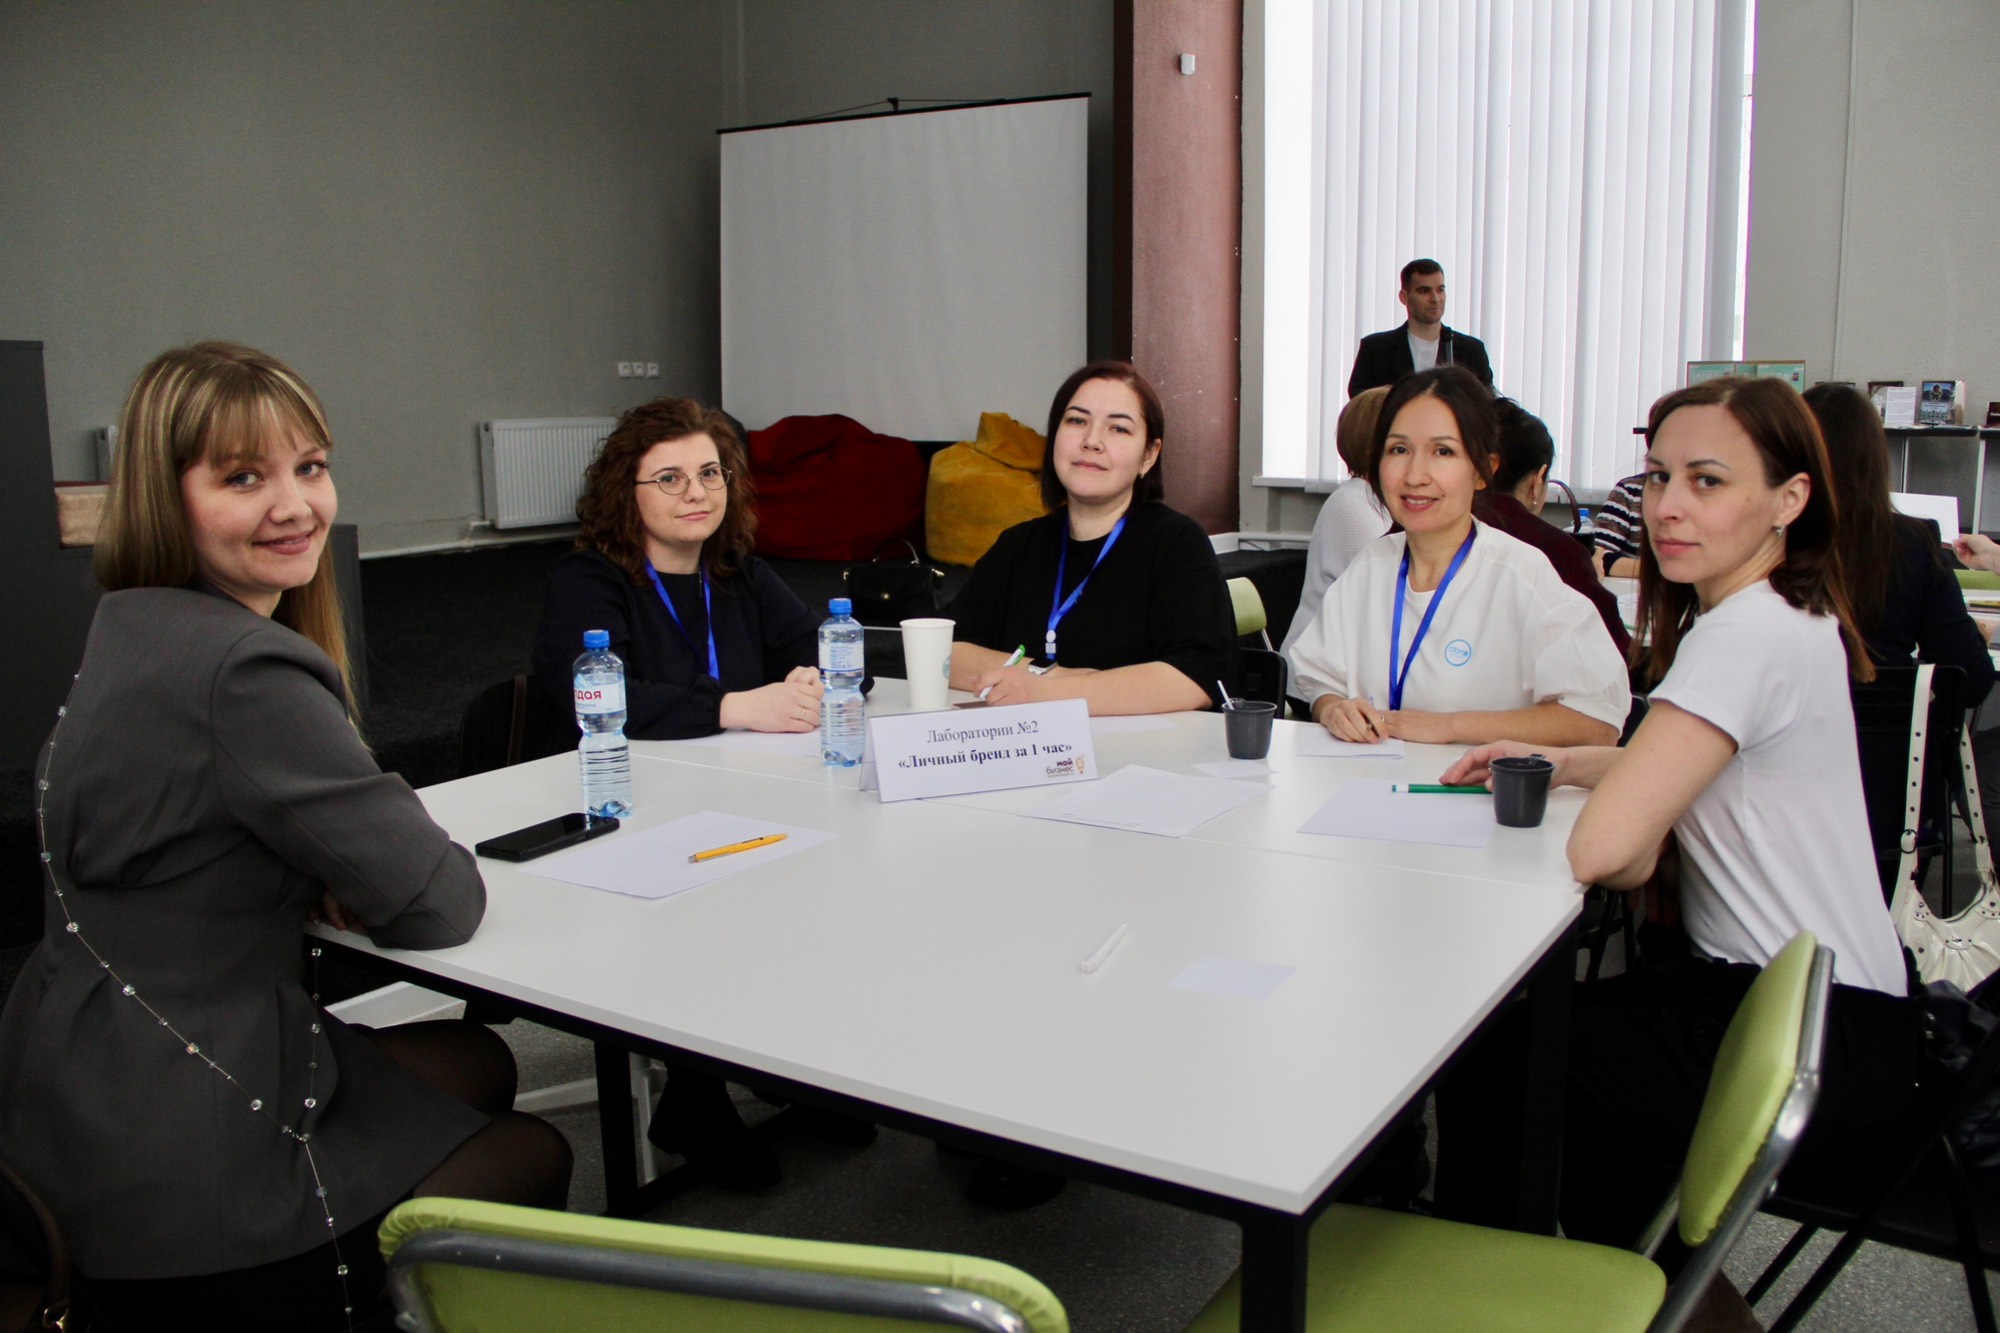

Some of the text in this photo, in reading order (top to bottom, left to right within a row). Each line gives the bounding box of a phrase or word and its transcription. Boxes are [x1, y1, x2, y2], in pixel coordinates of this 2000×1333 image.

[926, 720, 1038, 743] Лаборатории №2
[898, 743, 1072, 768] «Личный бренд за 1 час»
[1056, 757, 1073, 766] мой
[1046, 766, 1074, 774] бизнес
